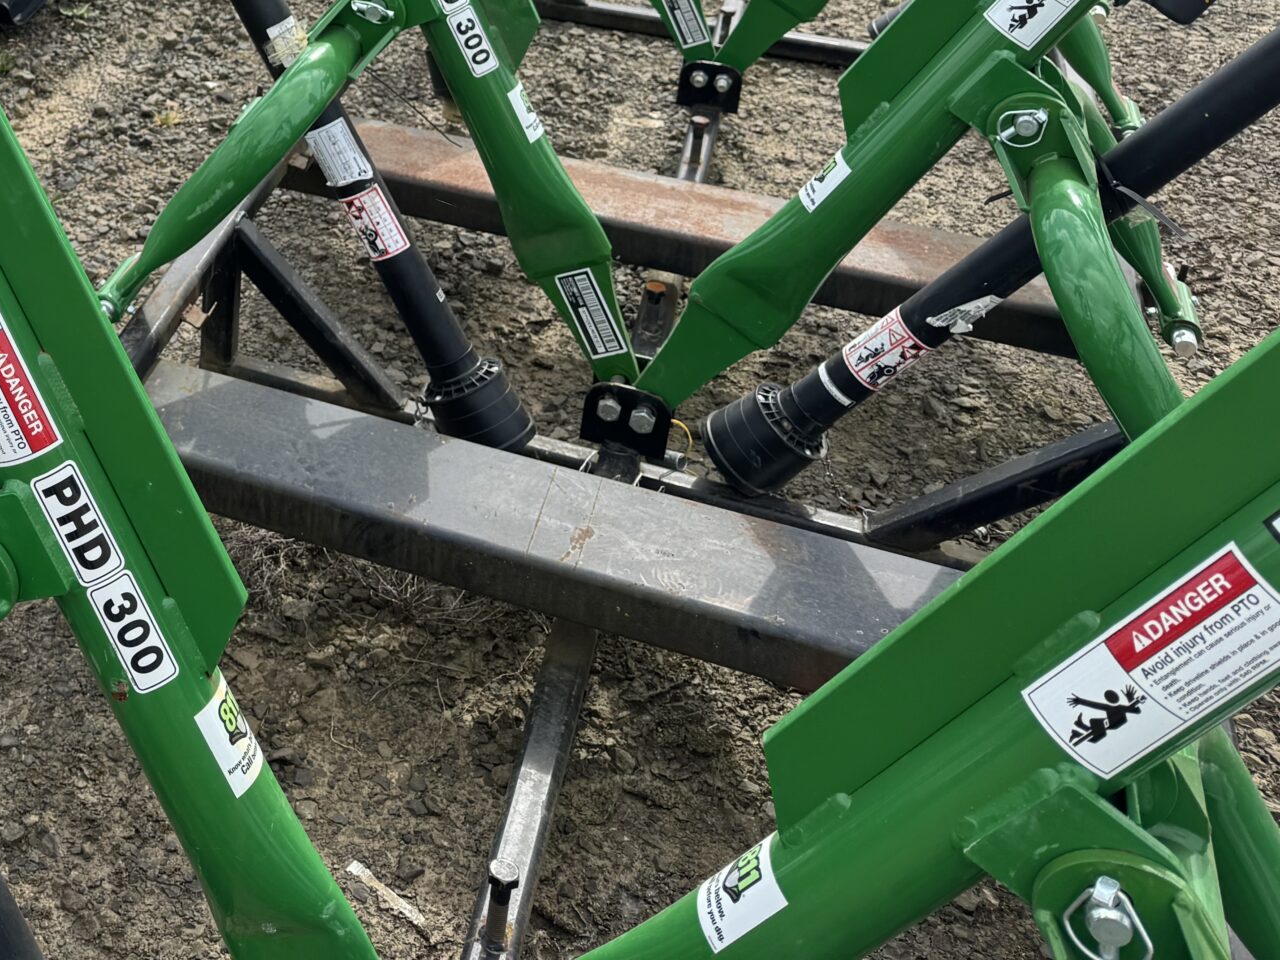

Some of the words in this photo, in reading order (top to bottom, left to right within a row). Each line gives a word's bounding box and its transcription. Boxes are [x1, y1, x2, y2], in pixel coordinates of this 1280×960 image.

[456, 18, 491, 65] 300
[3, 433, 13, 448] injury
[9, 428, 26, 450] PTO
[42, 474, 112, 570] PHD
[1143, 570, 1233, 641] DANGER
[103, 591, 164, 674] 300
[1139, 650, 1174, 680] Avoid
[1170, 628, 1207, 661] injury
[1202, 609, 1233, 636] from
[1230, 591, 1260, 617] PTO
[1153, 655, 1194, 686] Entanglement
[1193, 647, 1206, 660] can
[1205, 635, 1224, 651] cause
[1223, 620, 1247, 639] serious
[1245, 608, 1265, 624] injury
[1263, 603, 1272, 612] or
[1160, 675, 1181, 692] death.
[1167, 684, 1185, 699] Keep
[1183, 667, 1210, 688] driveline
[1208, 652, 1231, 671] shields
[1229, 648, 1238, 657] in
[1236, 636, 1255, 652] place
[1253, 632, 1261, 641] &
[1260, 627, 1268, 636] in
[1181, 694, 1199, 709] Keep
[1197, 681, 1218, 698] hands,
[1217, 673, 1231, 685] feet
[1230, 664, 1243, 676] and
[1242, 648, 1268, 668] clothing
[1175, 680, 1205, 704] condition.
[1189, 693, 1214, 713] Operate
[1212, 684, 1227, 697] only
[1226, 676, 1240, 688] with
[1239, 667, 1252, 679] 540
[226, 759, 242, 775] Know
[239, 755, 254, 774] Call
[707, 908, 717, 925] you
[714, 925, 724, 943] dig.
[713, 887, 725, 921] below.
